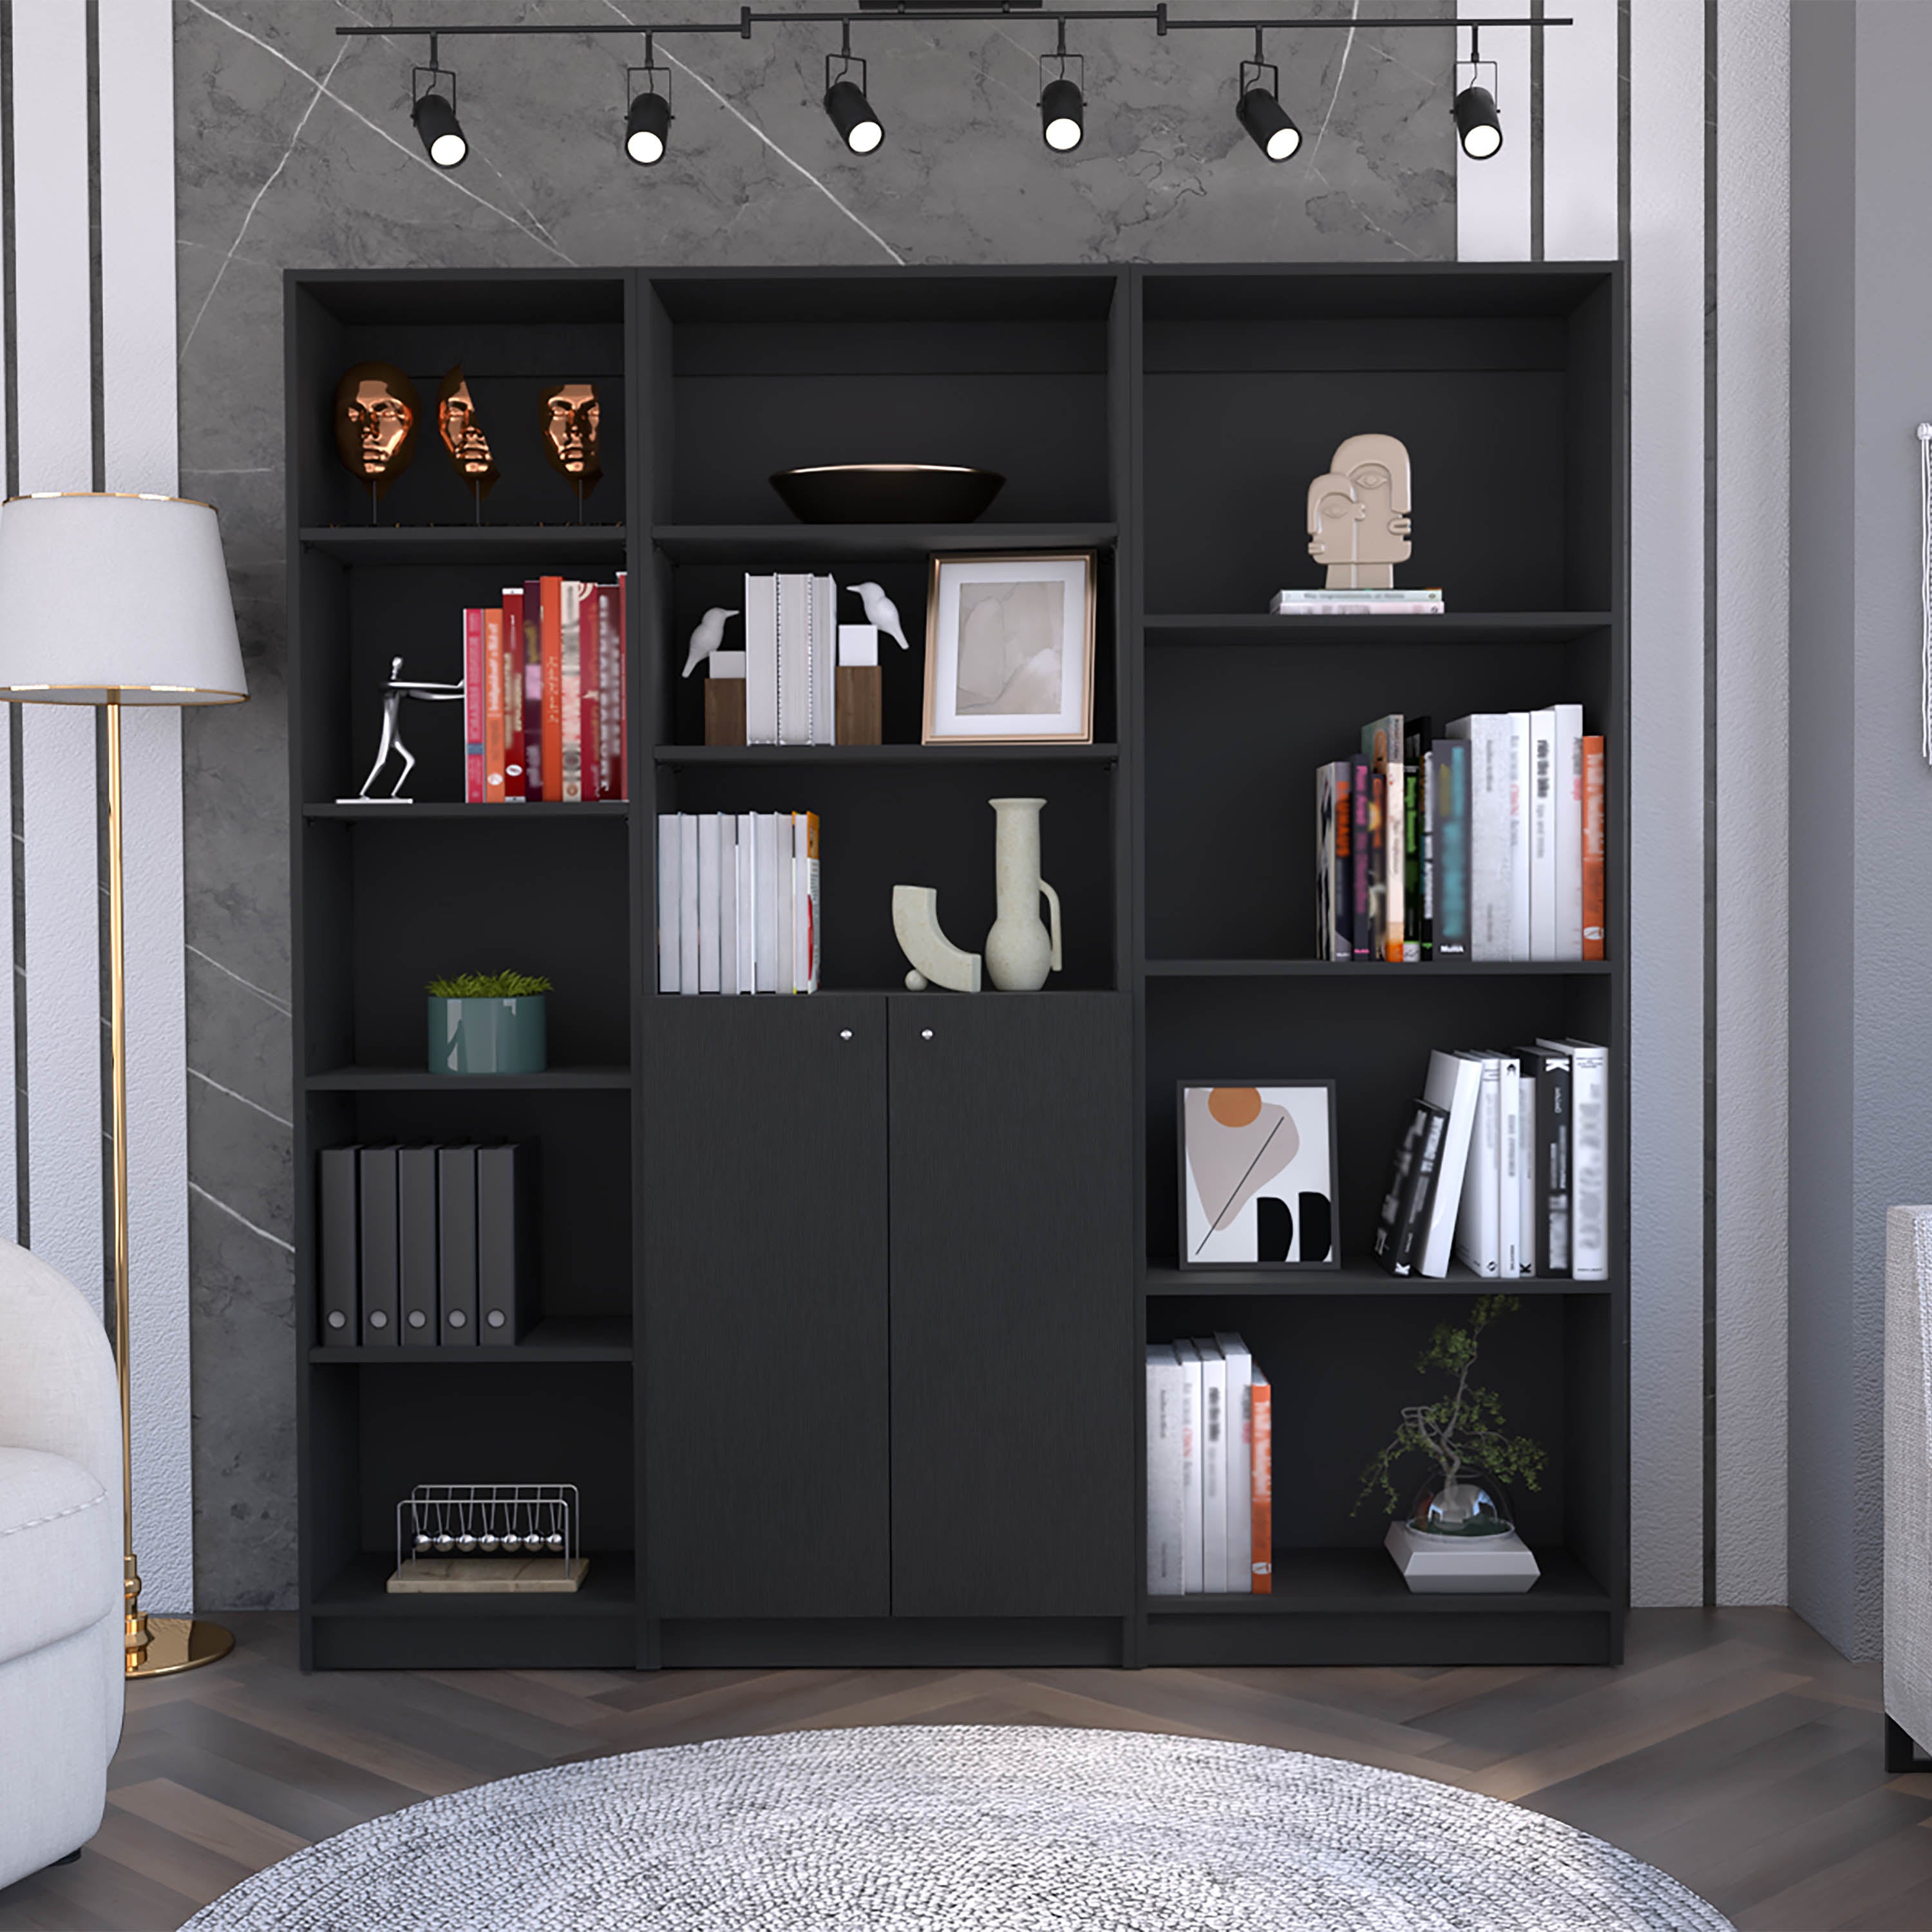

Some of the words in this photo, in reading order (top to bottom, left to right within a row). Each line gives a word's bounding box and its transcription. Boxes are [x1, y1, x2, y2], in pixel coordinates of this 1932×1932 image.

[1537, 761, 1548, 775] the
[1546, 1059, 1569, 1072] K
[1395, 1262, 1411, 1276] K
[1519, 1263, 1531, 1273] K
